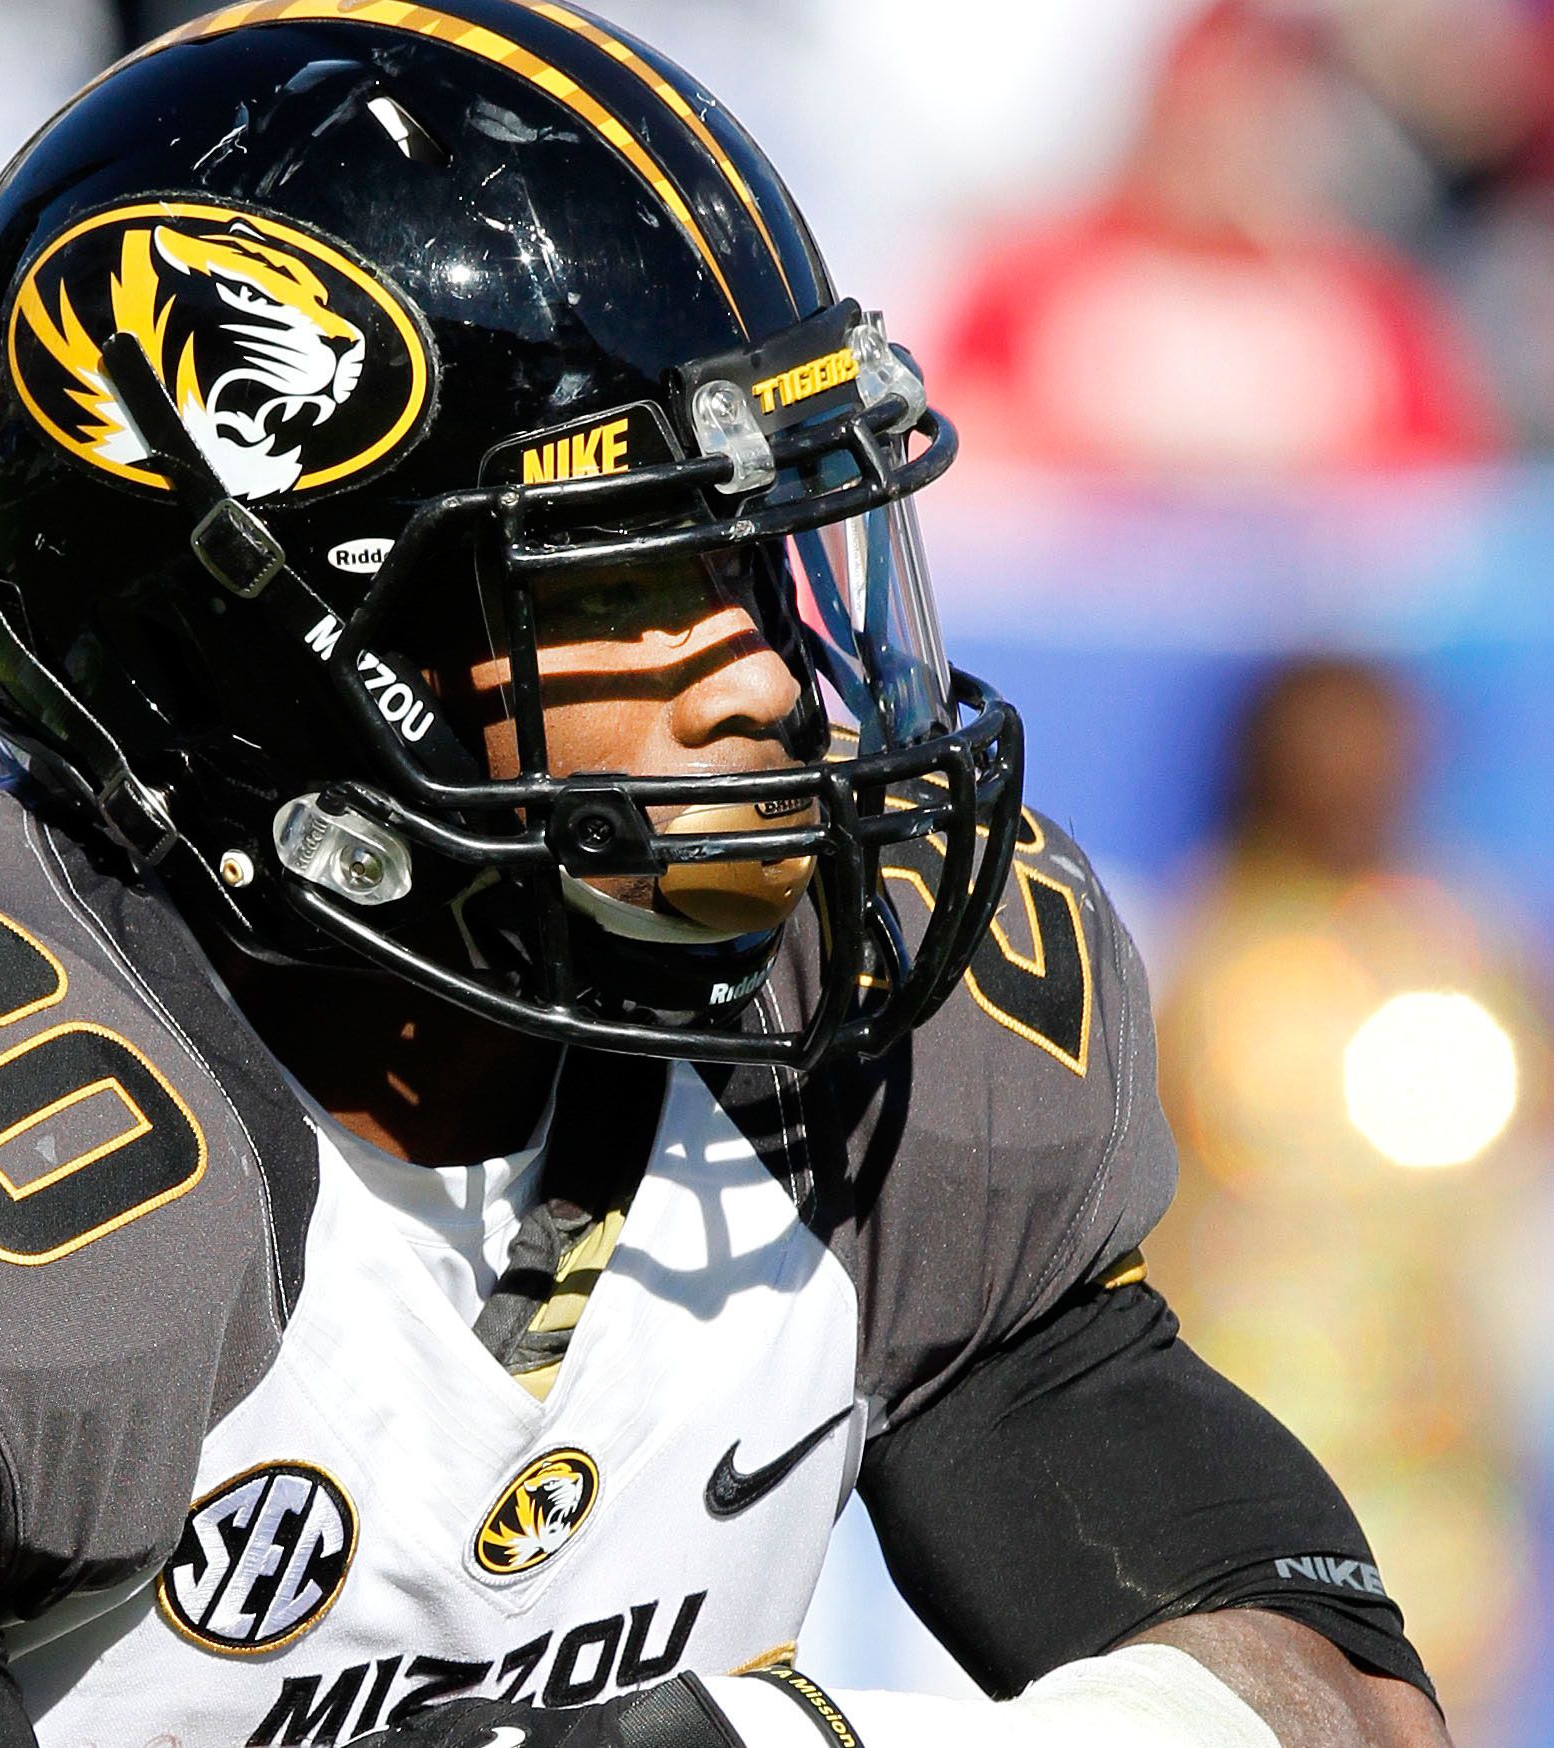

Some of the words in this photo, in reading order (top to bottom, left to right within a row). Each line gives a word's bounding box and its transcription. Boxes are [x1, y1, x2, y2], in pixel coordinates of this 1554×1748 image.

[522, 418, 629, 485] NIKE
[335, 548, 390, 567] Ridd
[173, 1474, 344, 1640] SEC
[1274, 1555, 1387, 1597] NIKE
[245, 1589, 709, 1748] MIZZOU
[789, 1677, 857, 1748] Mission
